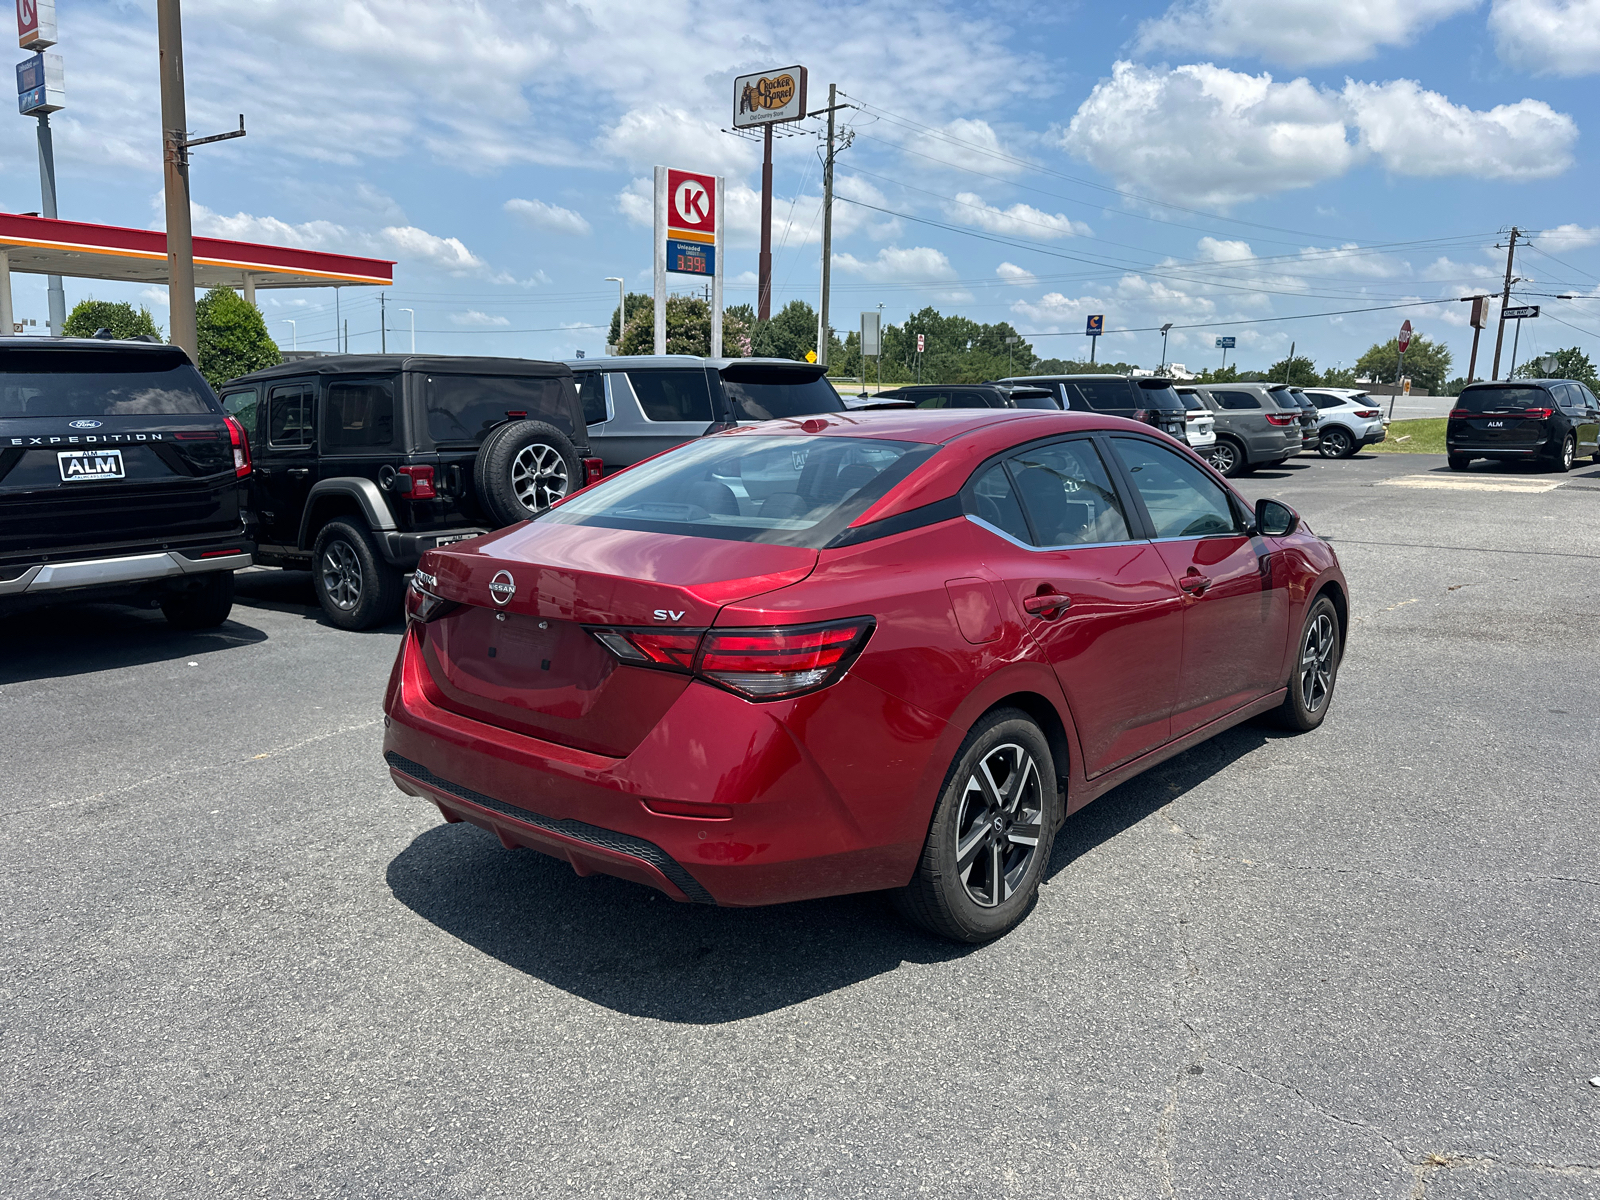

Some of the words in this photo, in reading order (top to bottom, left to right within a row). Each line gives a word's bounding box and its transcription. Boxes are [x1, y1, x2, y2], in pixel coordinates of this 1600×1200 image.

[757, 79, 790, 96] Cracker
[764, 87, 792, 108] Barrel
[685, 188, 705, 221] K
[1399, 330, 1411, 343] STOP
[77, 420, 97, 428] Ford
[11, 433, 163, 445] EXPEDITION
[67, 456, 117, 475] ALM
[489, 582, 516, 593] NISSAN
[653, 609, 686, 621] SV
